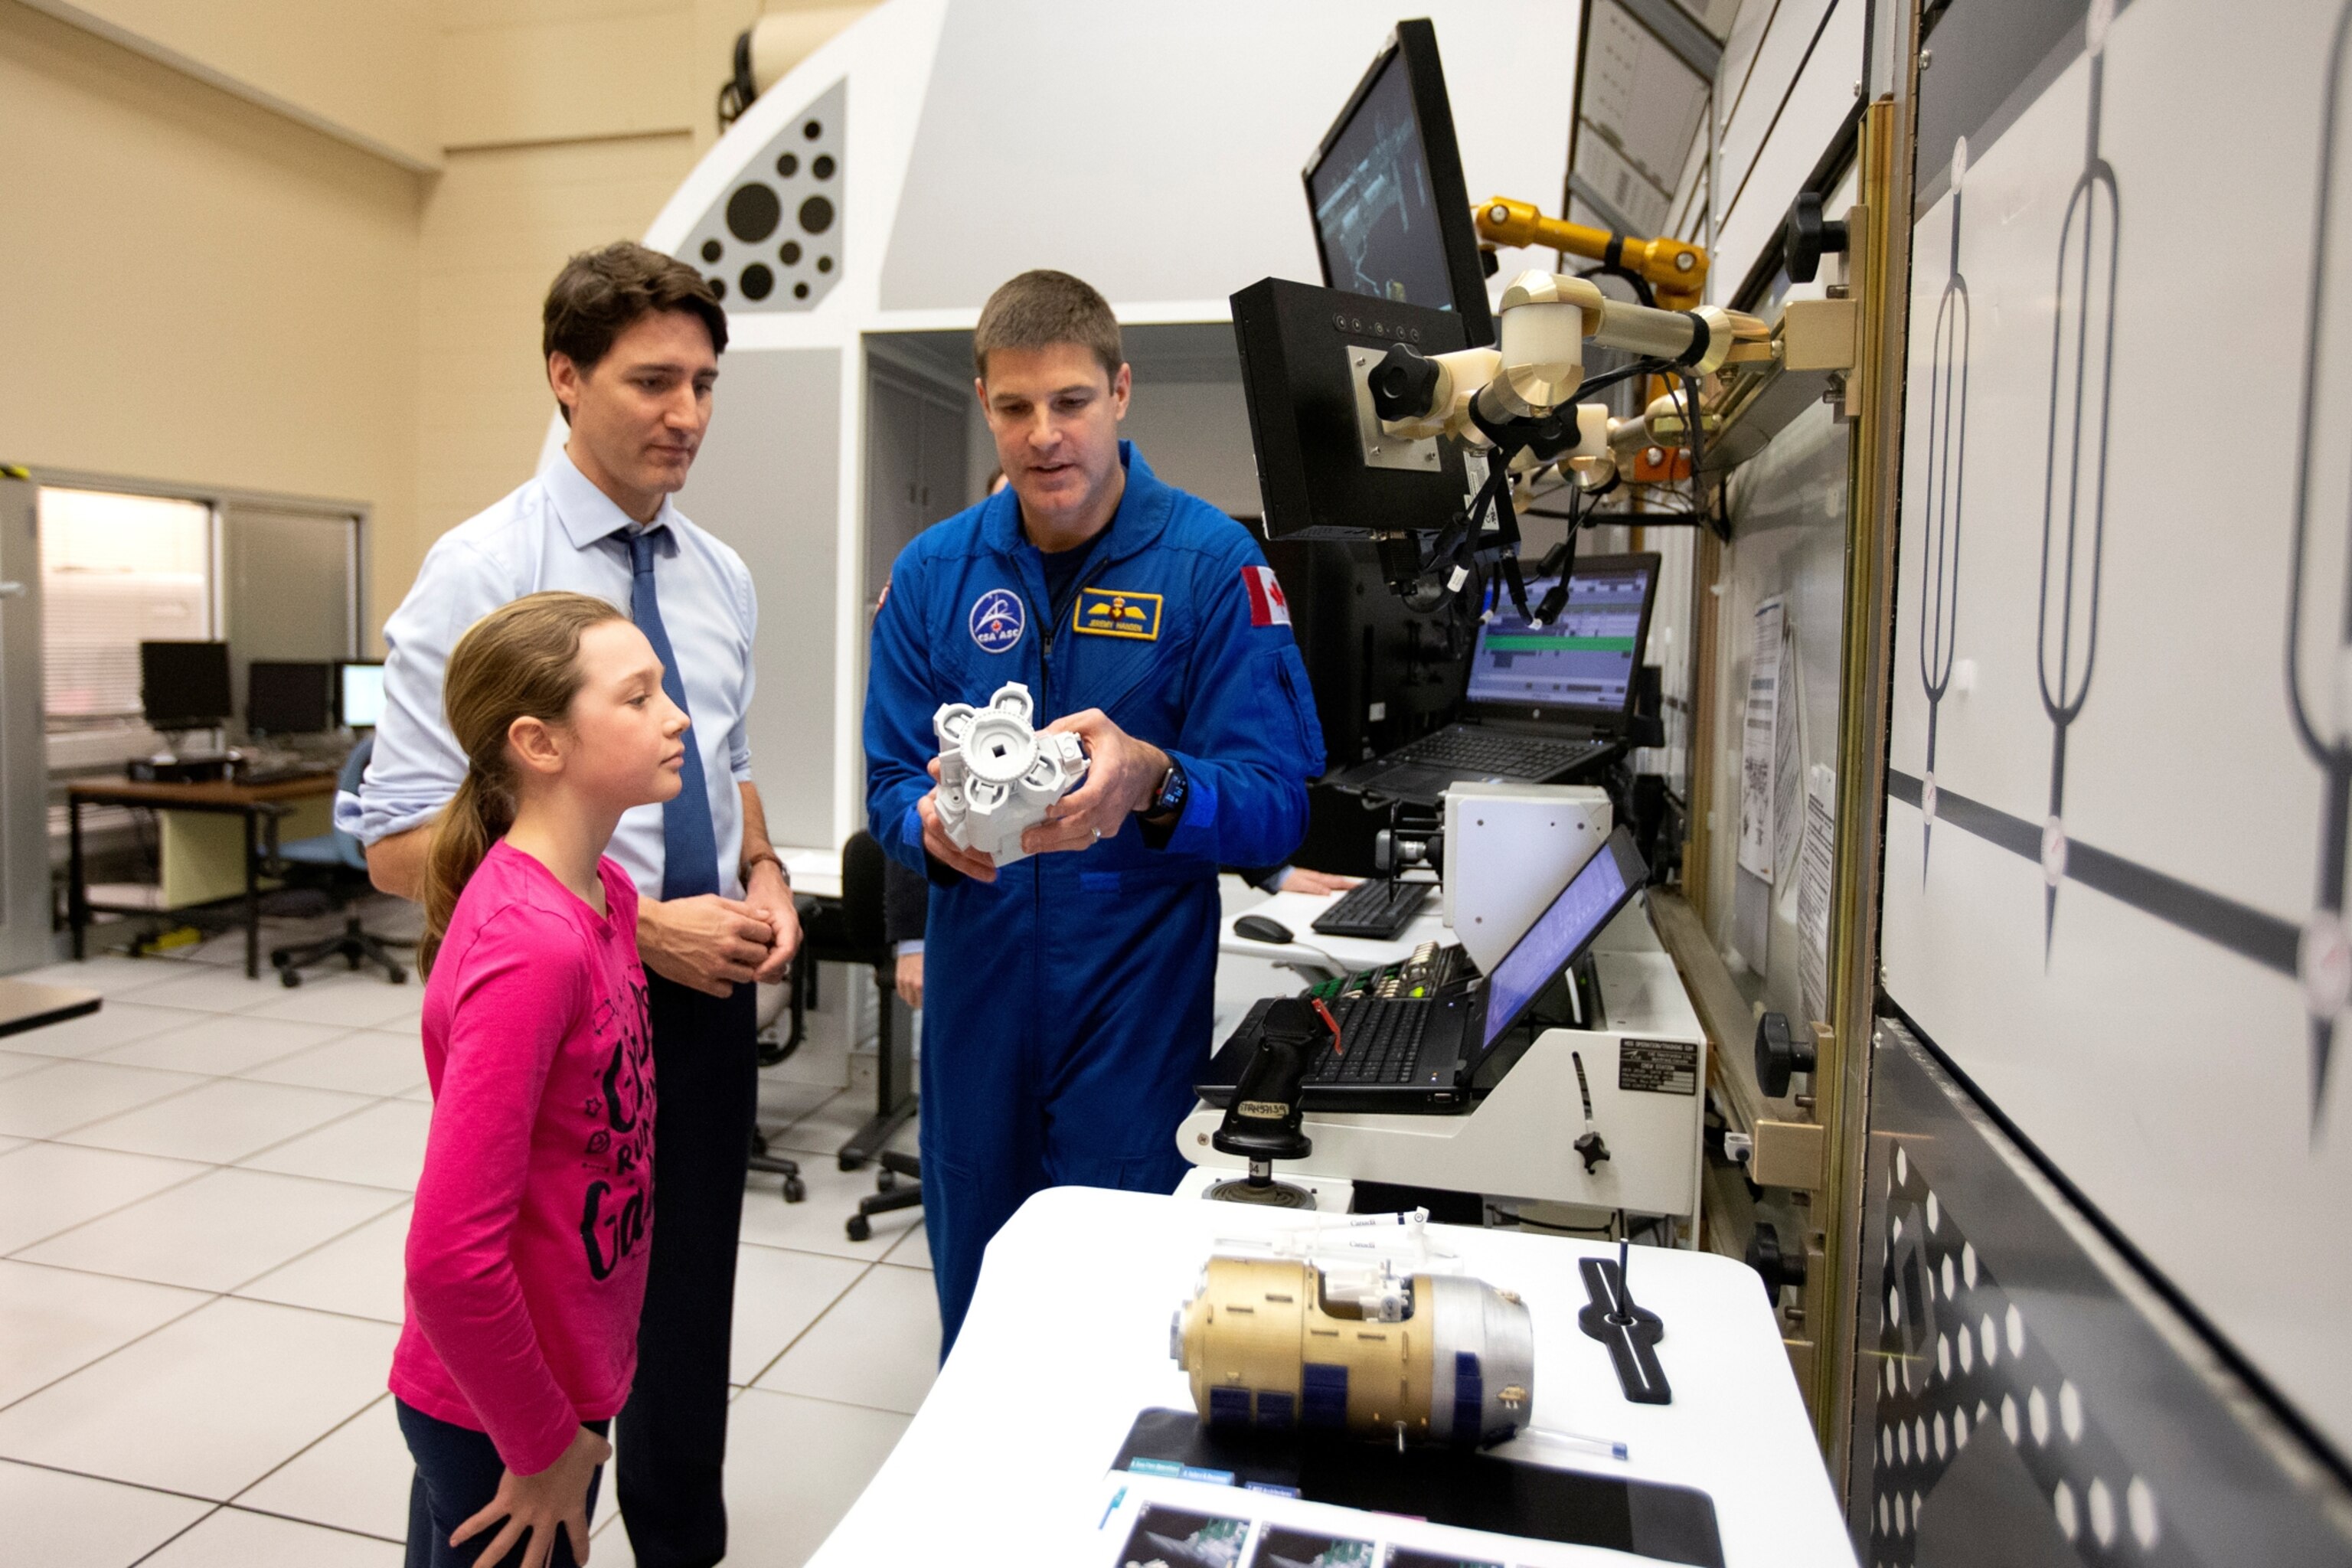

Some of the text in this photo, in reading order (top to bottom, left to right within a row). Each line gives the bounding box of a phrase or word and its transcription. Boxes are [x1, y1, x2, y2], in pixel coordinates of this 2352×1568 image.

[978, 629, 1019, 642] CSA ASC
[1350, 1218, 1376, 1227] Canada
